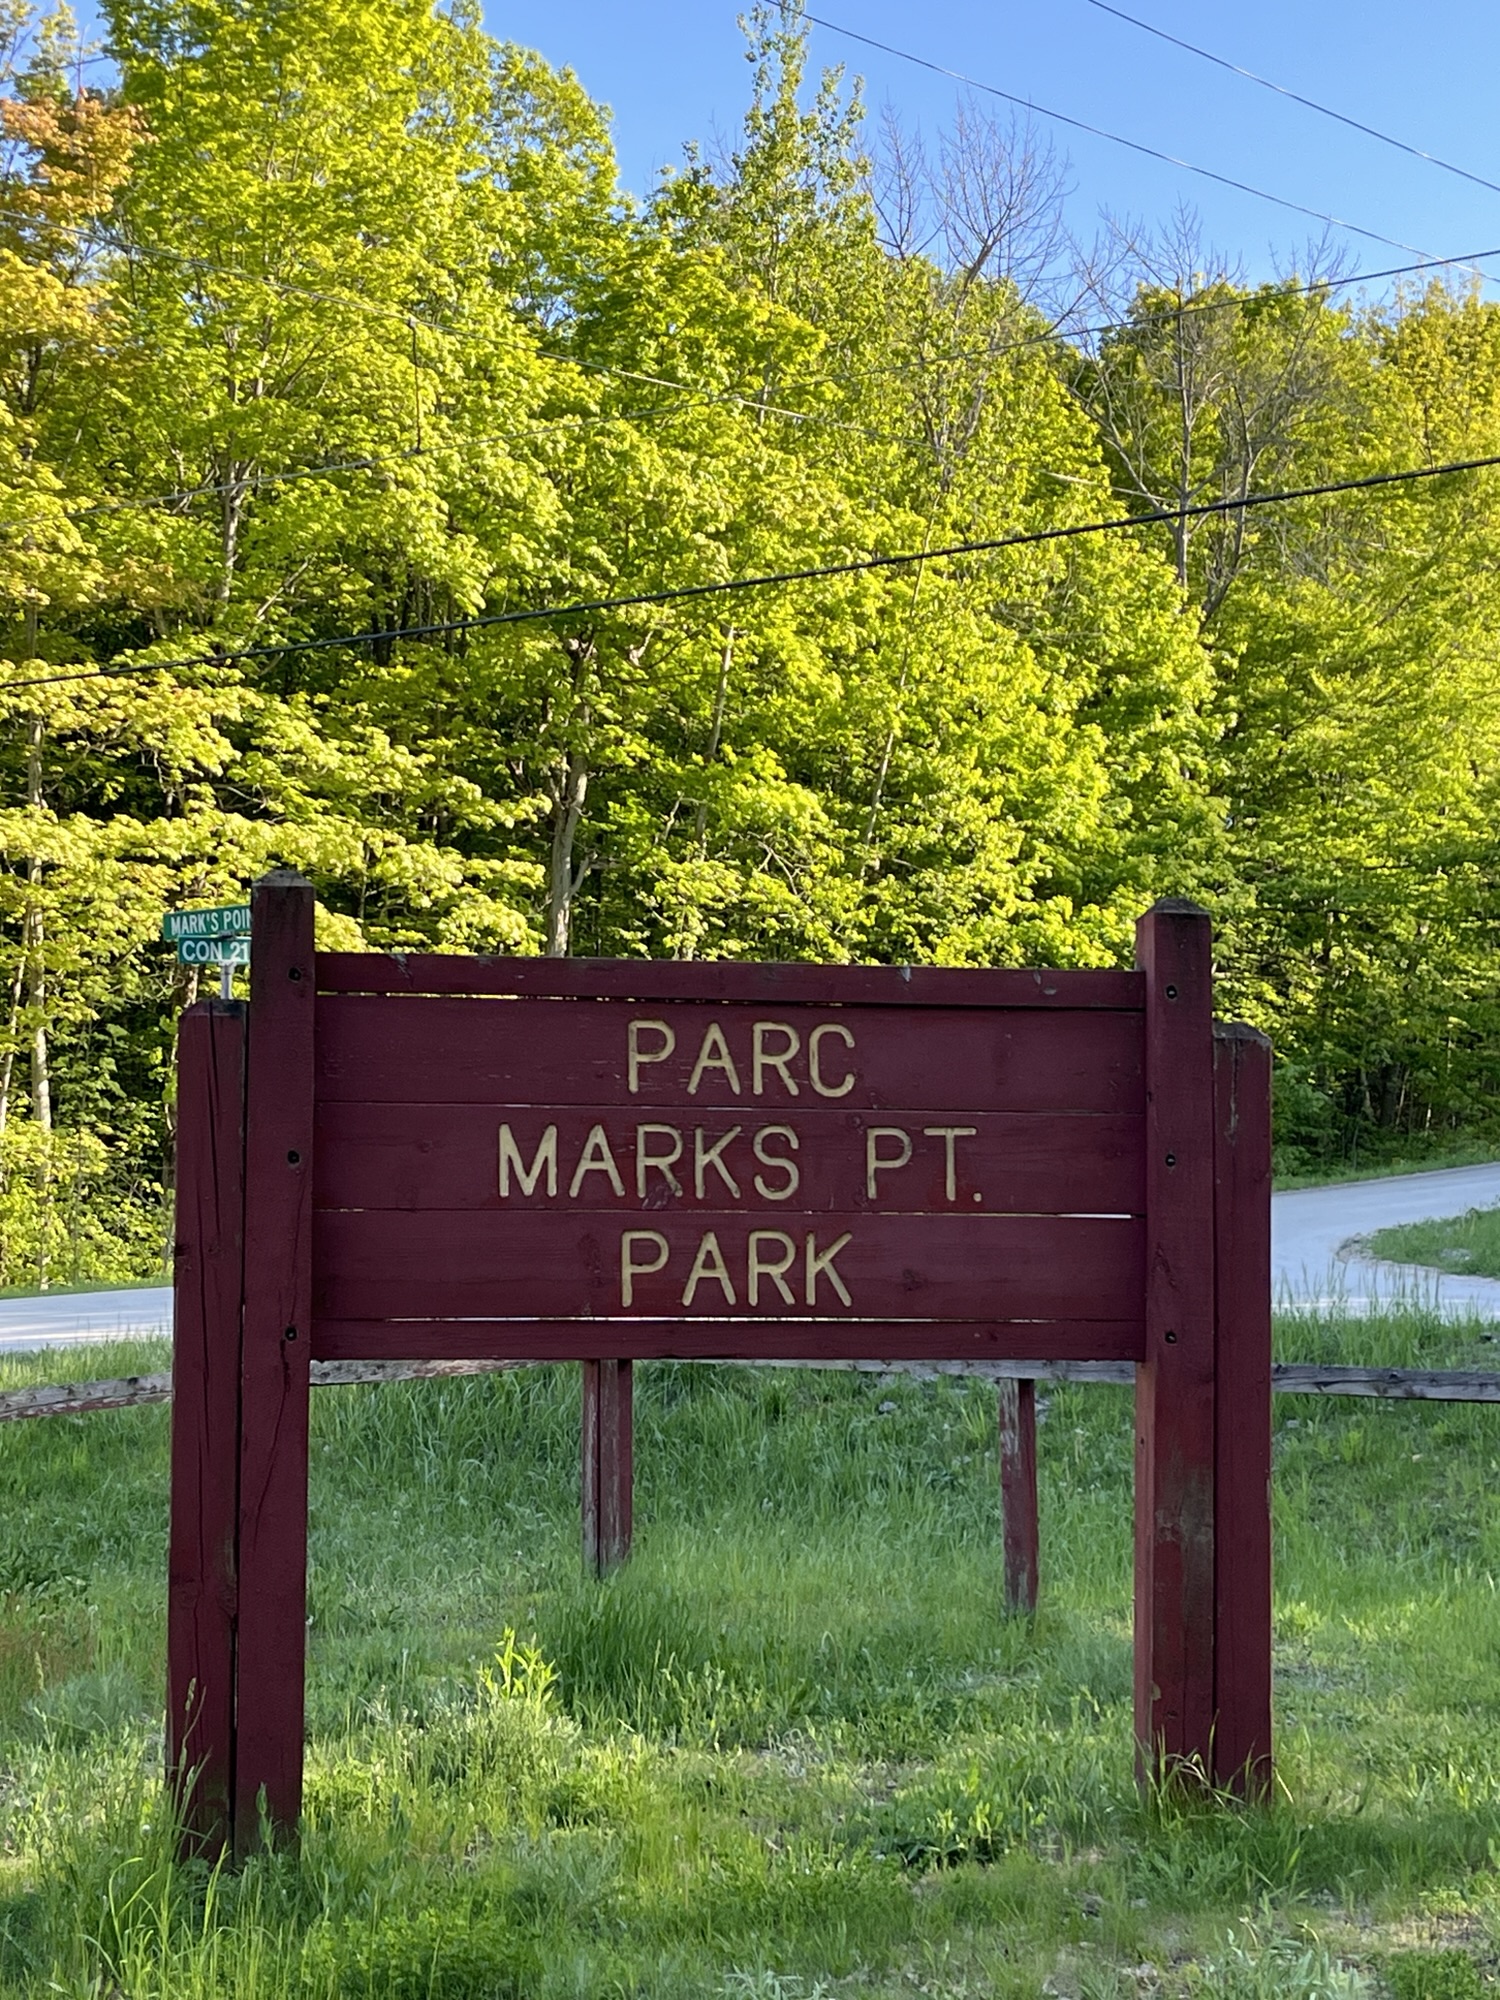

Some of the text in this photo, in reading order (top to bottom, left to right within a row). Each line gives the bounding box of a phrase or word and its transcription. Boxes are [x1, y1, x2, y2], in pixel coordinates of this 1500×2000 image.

[171, 912, 219, 936] MARK'S
[182, 940, 248, 961] CON 21
[628, 1019, 856, 1098] PARC
[498, 1123, 983, 1202] MARKS PT.
[621, 1230, 853, 1307] PARK
